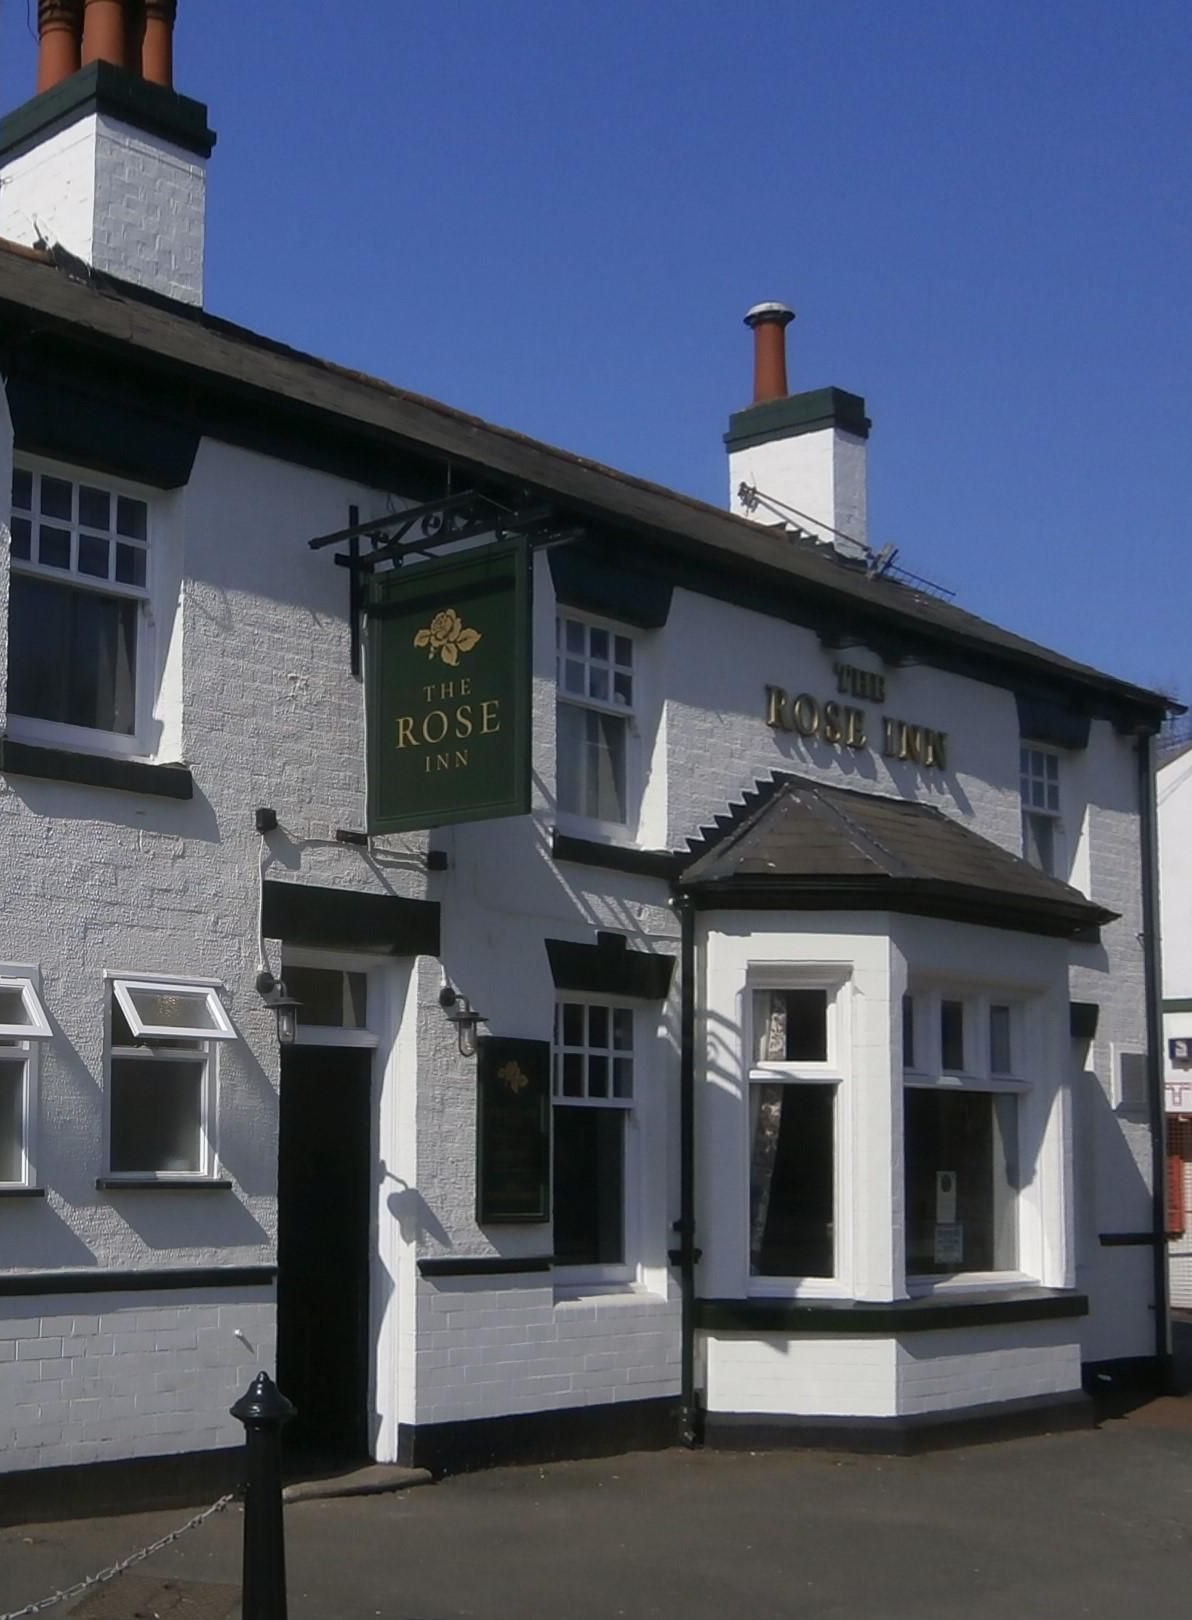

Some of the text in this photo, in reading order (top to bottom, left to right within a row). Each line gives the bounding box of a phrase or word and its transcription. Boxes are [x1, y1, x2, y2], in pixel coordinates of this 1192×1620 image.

[424, 678, 471, 702] THE
[833, 662, 886, 703] THE
[395, 700, 500, 748] ROSE
[765, 684, 948, 771] ROSE INN
[425, 751, 468, 772] INN
